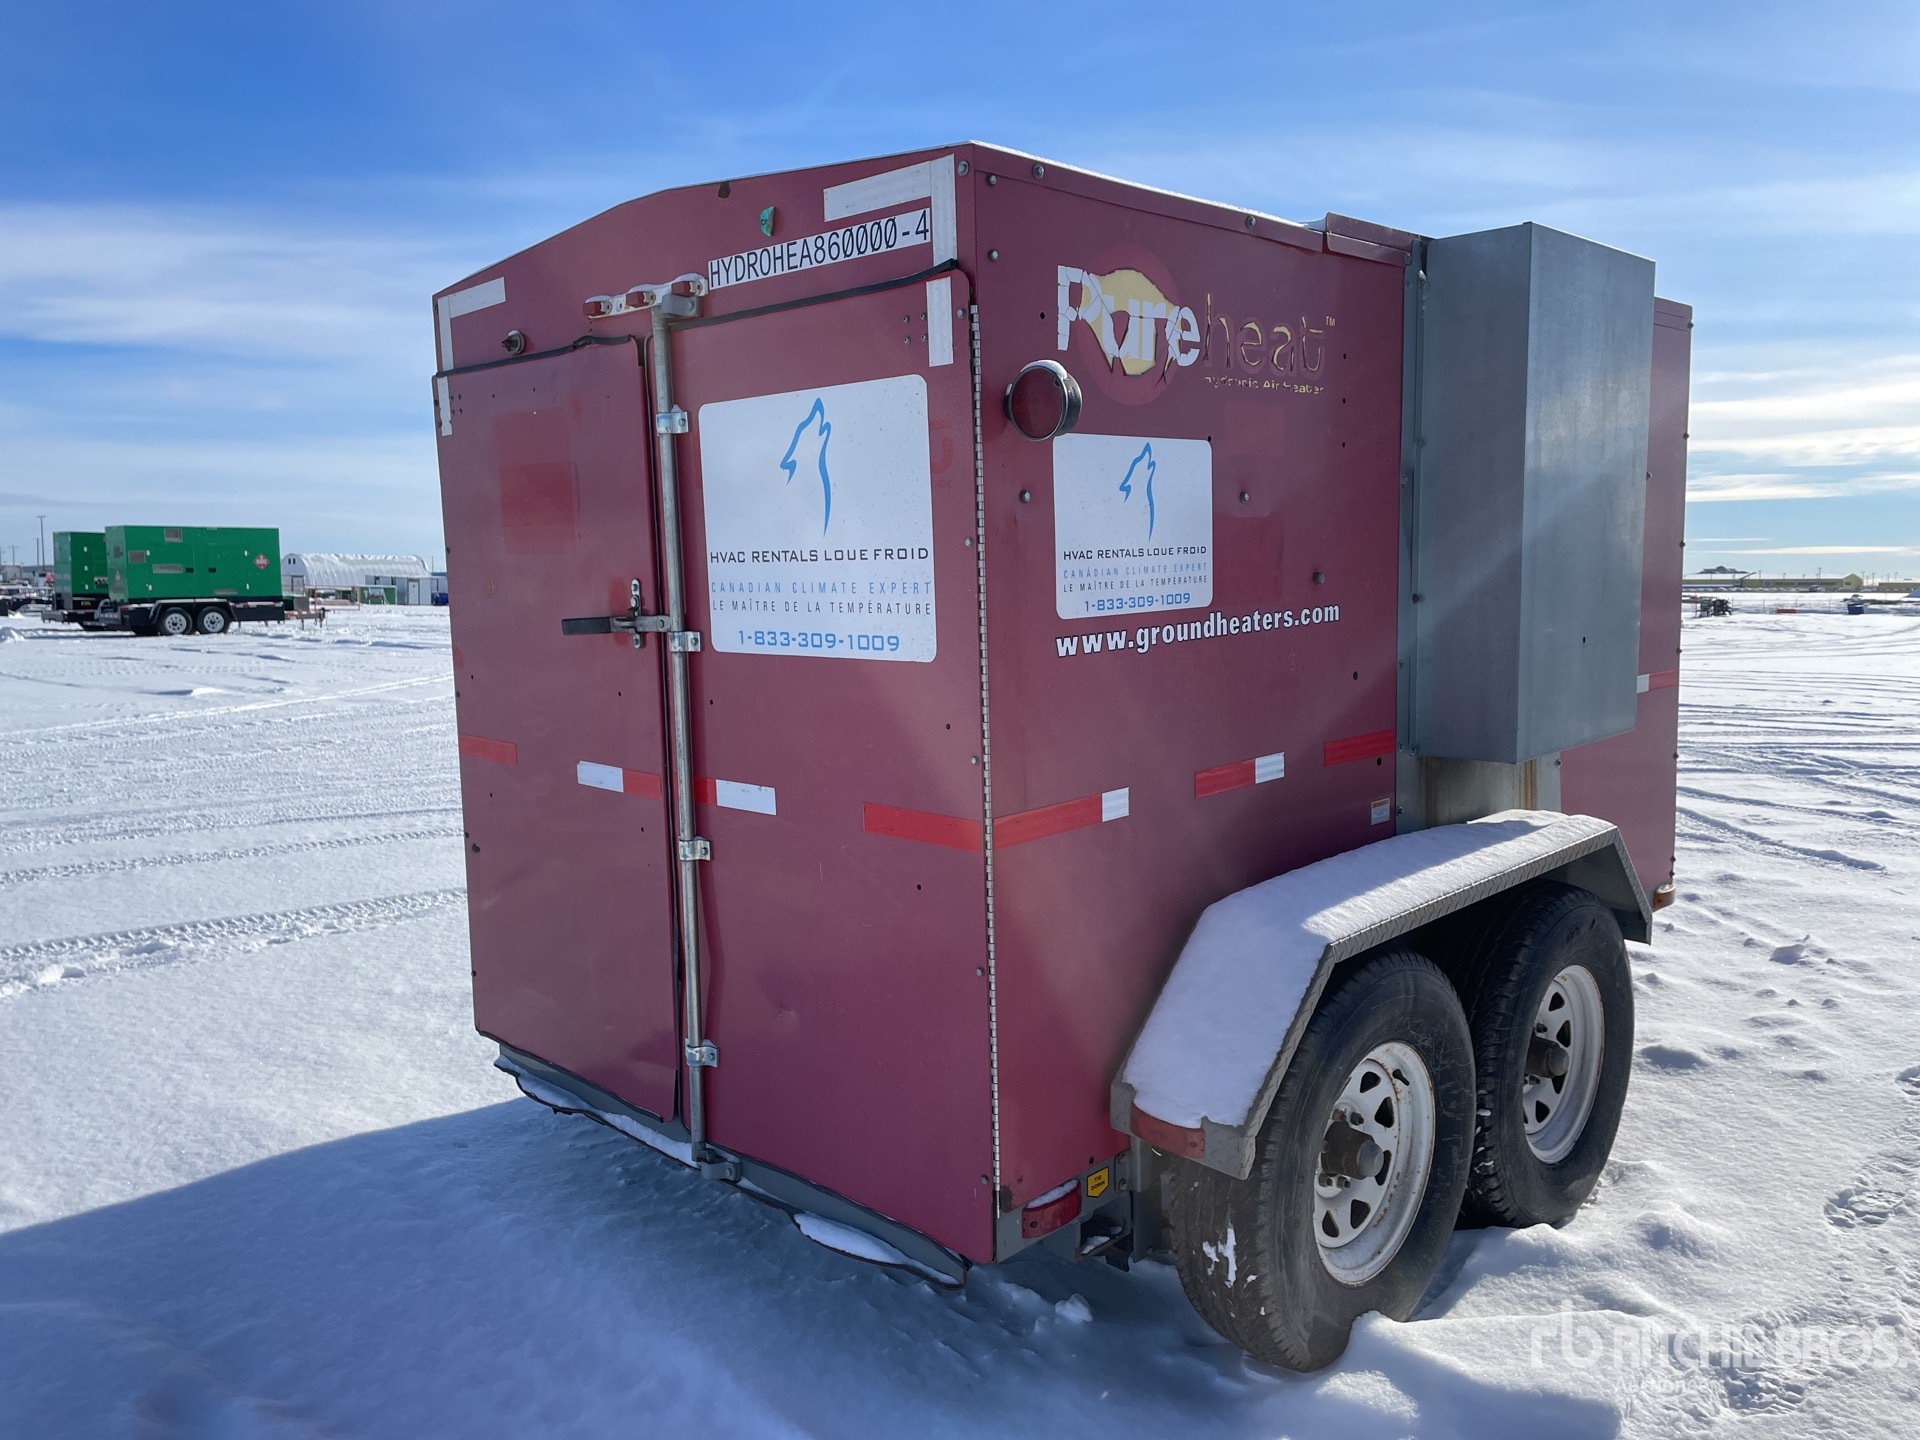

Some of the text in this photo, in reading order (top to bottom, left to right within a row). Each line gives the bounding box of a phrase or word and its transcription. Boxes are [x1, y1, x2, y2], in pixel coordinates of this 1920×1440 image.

[1263, 379, 1280, 391] Air
[710, 547, 929, 564] HVAC RENTALS LOUE FROID
[1063, 546, 1207, 561] HVAC RENTALS LOUE FROID
[1063, 562, 1207, 579] CANADIAN CLIMATE EXPERT
[711, 581, 932, 595] CANADIAN CLIMATE EXPERT
[1063, 582, 1074, 593] LE
[1120, 580, 1130, 589] DE
[1135, 579, 1145, 588] LA
[1150, 575, 1208, 587] TEMPÉRATURE
[712, 598, 931, 615] LE MAÎTRE DE LA TEMPÉRATURE
[1084, 592, 1191, 612] 1-833-309-1009
[1056, 604, 1340, 657] www.groundheaters.com
[738, 630, 900, 651] 1-833-309-1009
